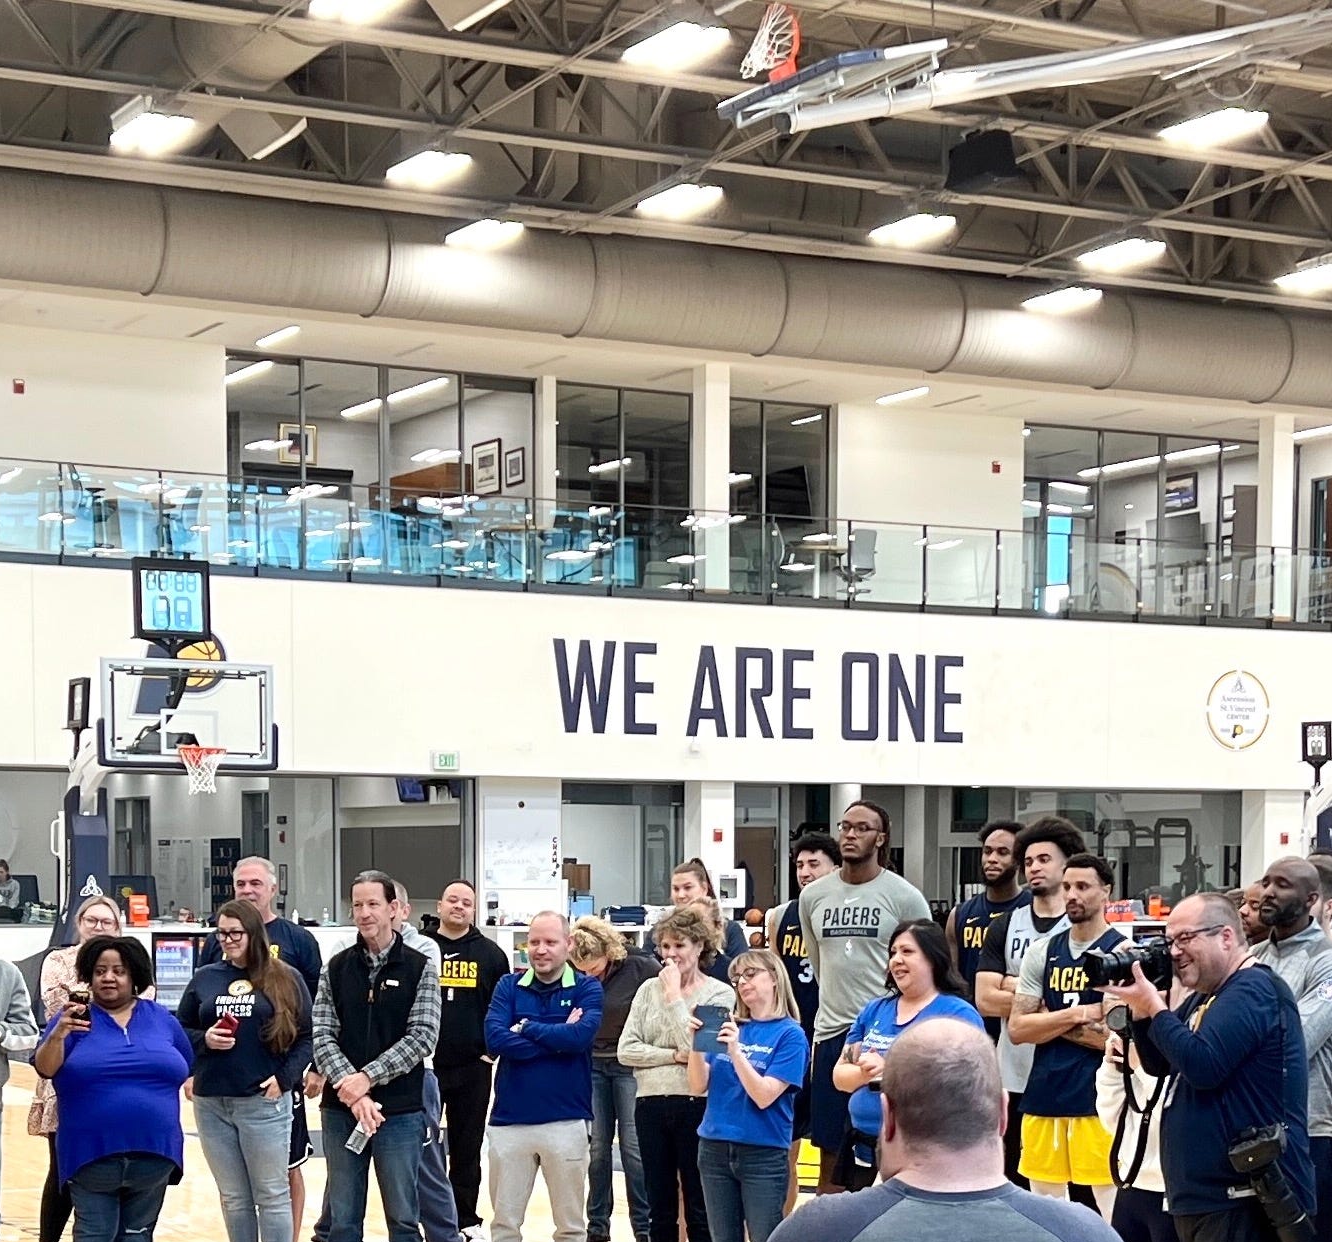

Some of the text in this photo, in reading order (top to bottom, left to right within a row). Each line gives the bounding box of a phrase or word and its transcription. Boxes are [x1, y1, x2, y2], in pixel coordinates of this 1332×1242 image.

[553, 638, 964, 743] WE ARE ONE
[439, 754, 455, 768] EXIT
[822, 907, 881, 927] PACERS
[443, 960, 478, 978] CERS
[215, 994, 256, 1005] INDIANA
